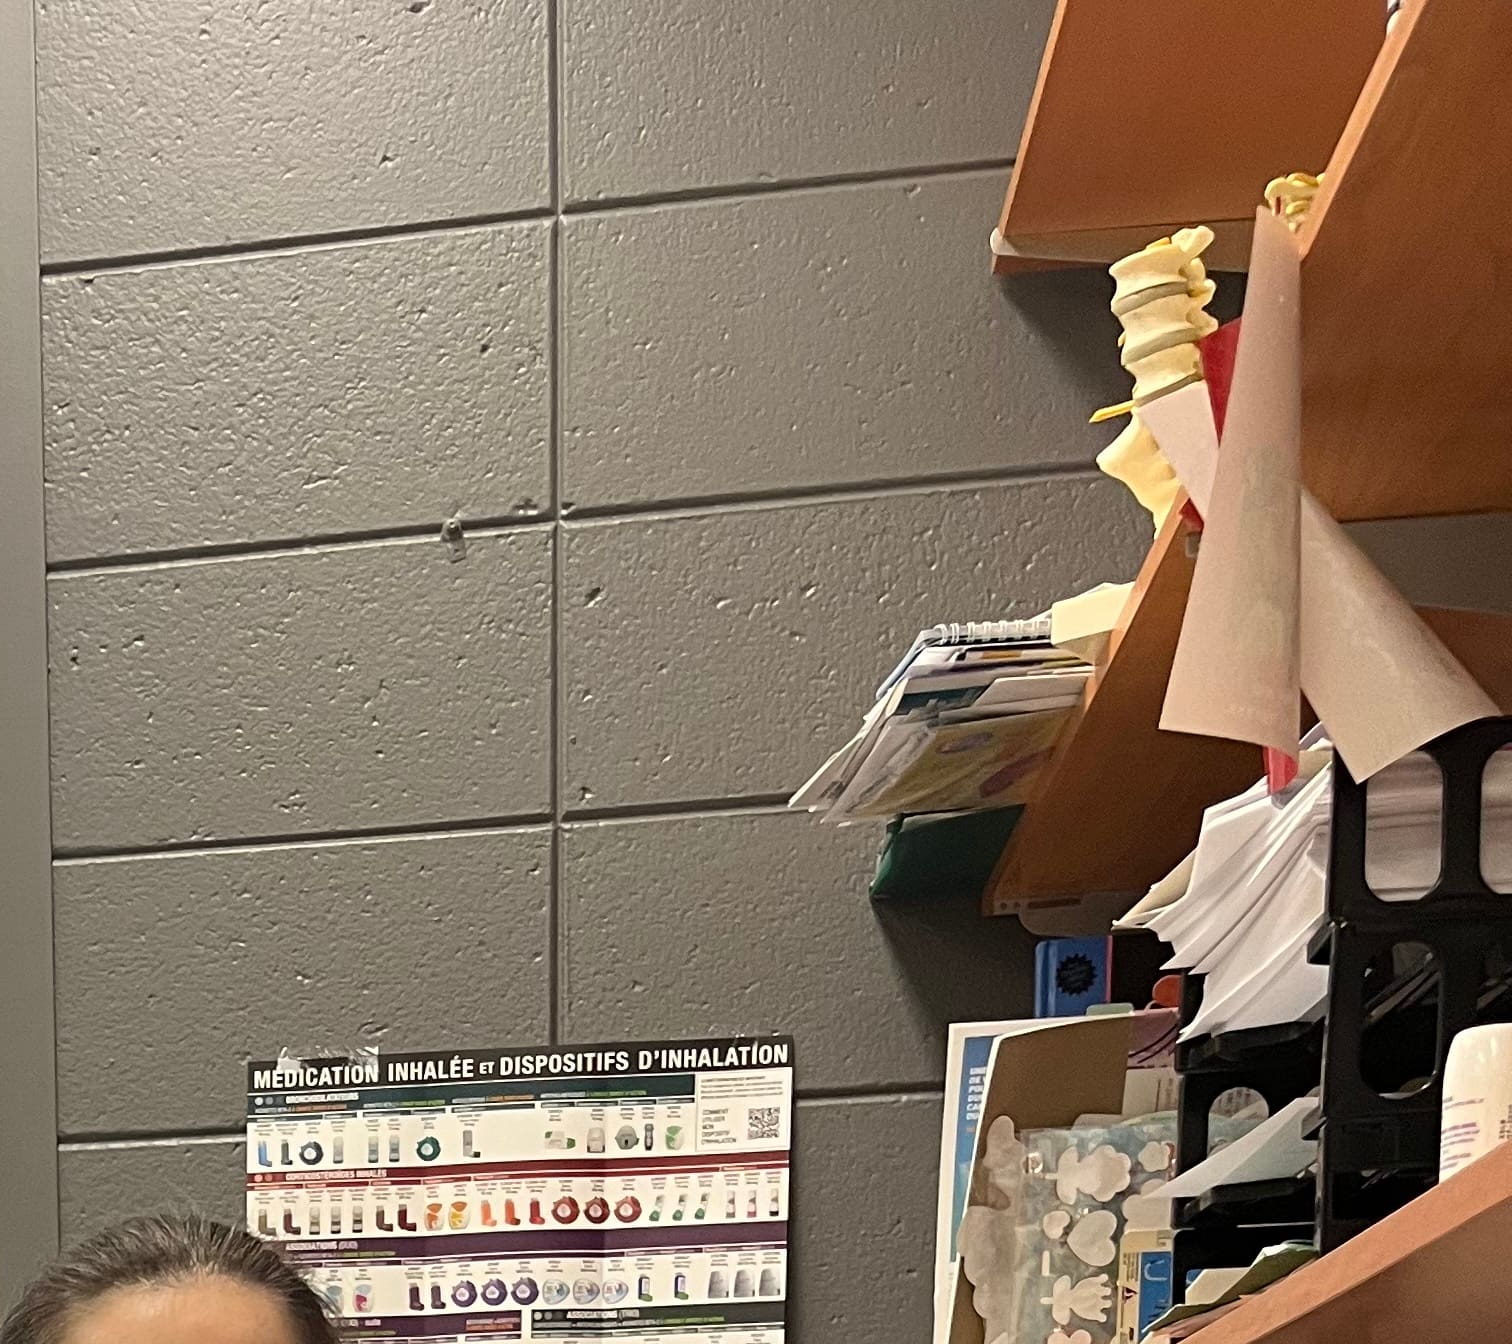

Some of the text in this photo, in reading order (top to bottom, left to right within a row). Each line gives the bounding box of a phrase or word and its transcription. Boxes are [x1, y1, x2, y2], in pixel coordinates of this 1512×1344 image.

[388, 1055, 474, 1081] INHALÉE
[479, 1061, 495, 1074] ET
[499, 1051, 629, 1076] DISPOSITIFS
[638, 1044, 788, 1070] D'INHALATION
